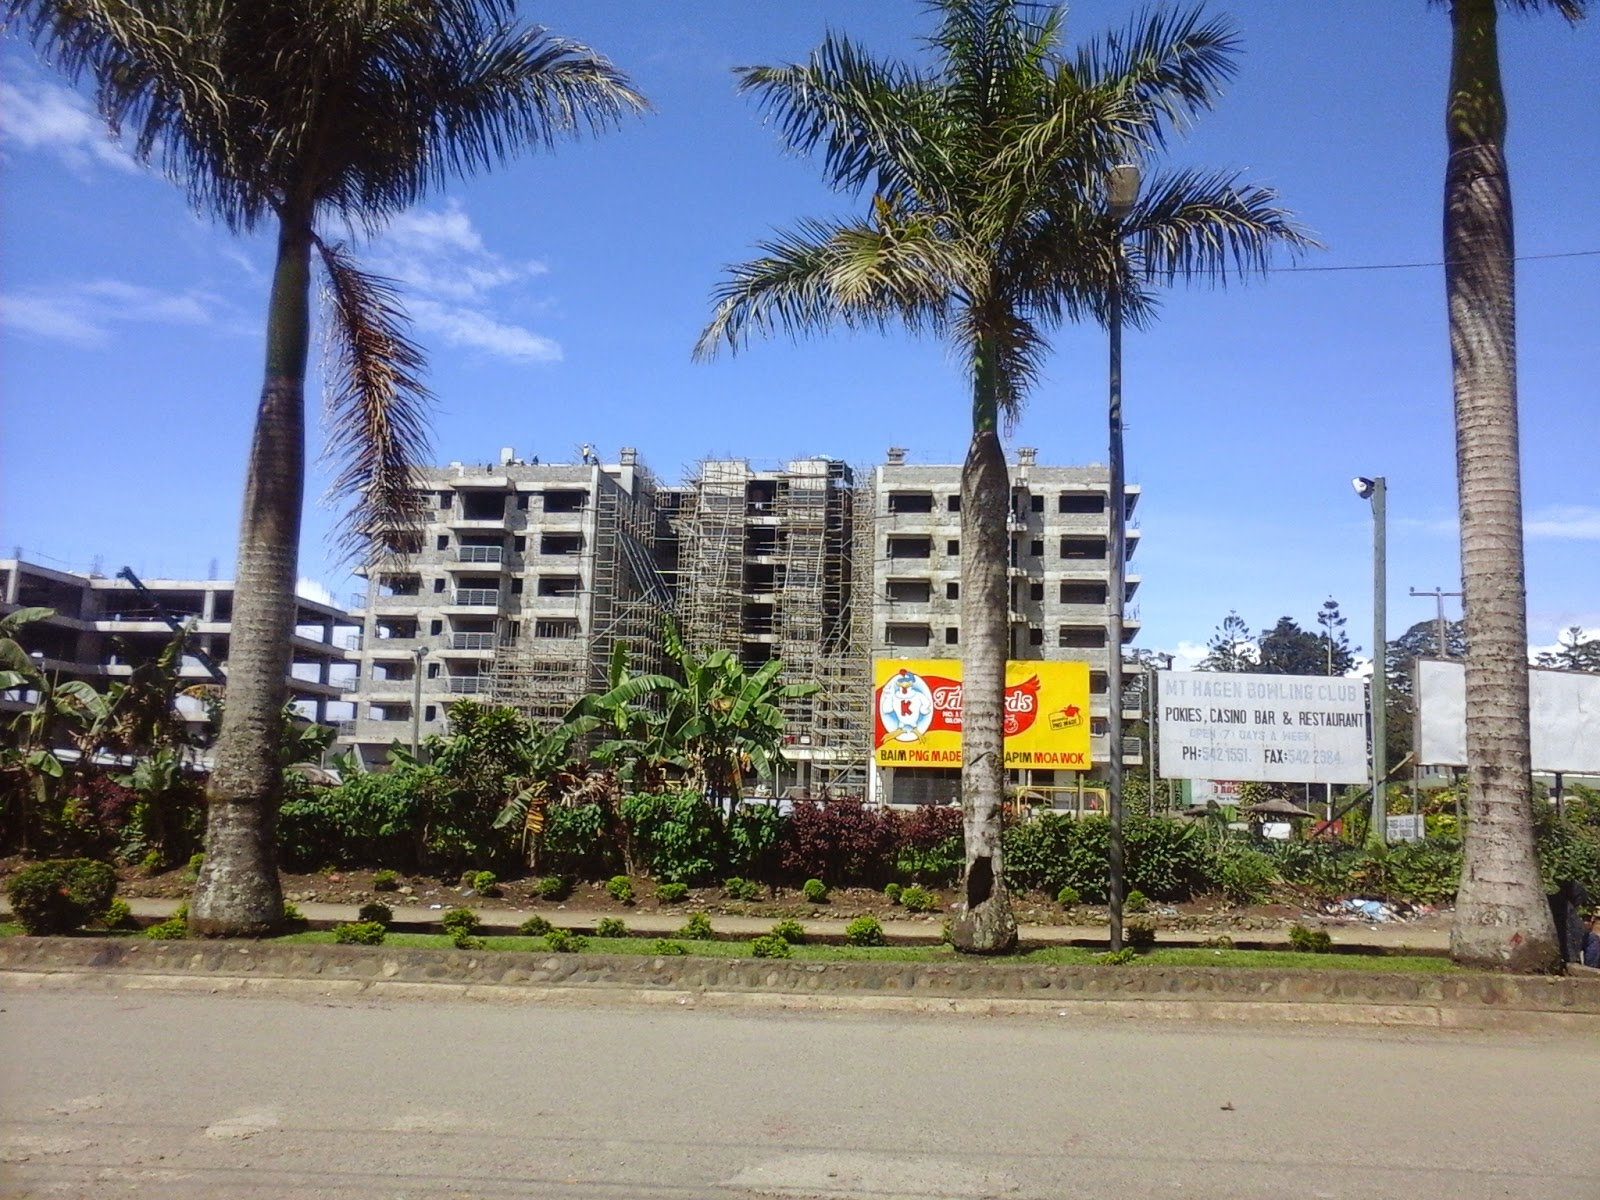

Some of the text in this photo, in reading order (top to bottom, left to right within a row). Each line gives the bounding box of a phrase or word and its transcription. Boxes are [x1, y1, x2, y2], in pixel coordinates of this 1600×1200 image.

[1166, 680, 1357, 701] MT HAGEN BOWLING CLUB
[900, 700, 912, 717] K
[1210, 708, 1247, 724] CASINO
[1255, 710, 1276, 726] BAR
[1283, 711, 1293, 726] &
[1299, 711, 1364, 728] RESTAURANT
[1189, 728, 1216, 739] OPEN
[1239, 730, 1266, 741] DAYS
[1270, 731, 1277, 741] A
[1282, 731, 1312, 742] WEEK
[880, 749, 1085, 765] BAIM PNG MADE APIM MOA WOK
